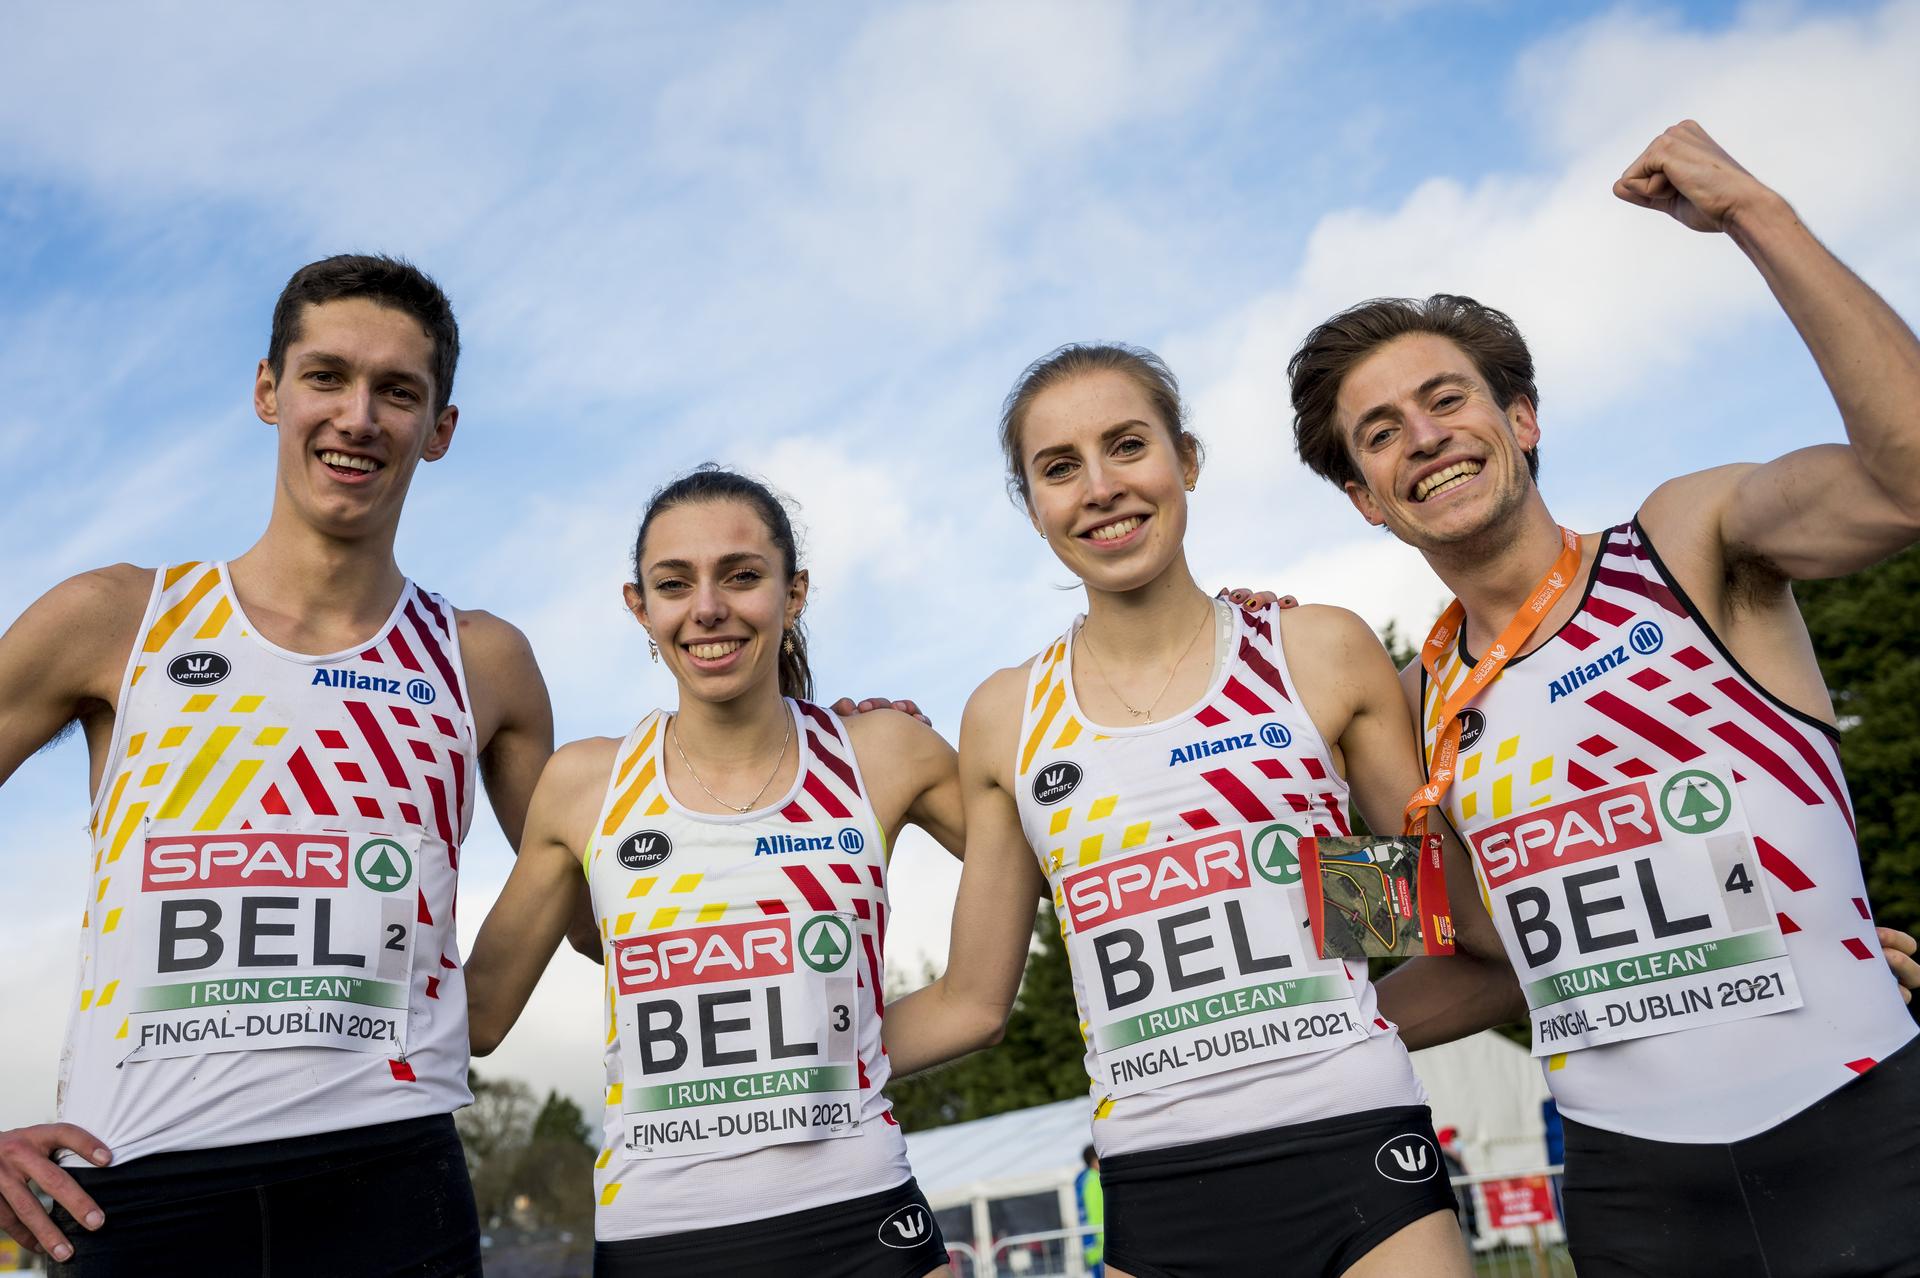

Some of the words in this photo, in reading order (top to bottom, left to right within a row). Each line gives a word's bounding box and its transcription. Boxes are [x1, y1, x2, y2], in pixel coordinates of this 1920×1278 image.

[177, 671, 220, 680] vermarc
[311, 668, 401, 695] Allianz
[1548, 645, 1630, 704] Allianz
[1169, 732, 1257, 767] Allianz
[1459, 728, 1479, 742] marc
[1038, 781, 1072, 799] vermarc
[754, 835, 834, 857] Allianz
[1481, 793, 1652, 878] SPAR
[149, 841, 342, 883] SPAR
[624, 852, 662, 863] vermarc
[1070, 840, 1243, 922] SPAR
[1505, 857, 1712, 969] BEL
[1724, 863, 1754, 894] 4
[157, 897, 366, 973] BEL
[385, 924, 406, 951] 2
[620, 927, 788, 986] SPAR
[1093, 900, 1292, 1011] BEL
[191, 985, 196, 1003] I
[204, 981, 260, 1002] RUN
[1553, 979, 1562, 997] I
[1562, 966, 1610, 995] RUN
[1138, 1018, 1146, 1037] I
[1149, 1006, 1199, 1034] RUN
[1540, 986, 1713, 1043] FINGAL-DUBLIN
[1717, 972, 1786, 1007] 2021
[141, 1013, 344, 1047] FINGAL-DUBLIN
[347, 1015, 396, 1041] 2021
[637, 986, 818, 1075] BEL
[833, 1005, 850, 1032] 3
[1109, 1020, 1290, 1085] FINGAL-DUBLIN
[1293, 1011, 1353, 1040] 2021
[668, 1087, 673, 1105] I
[678, 1080, 726, 1105] RUN
[634, 1106, 806, 1146] FINGAL-DUBLIN
[812, 1103, 852, 1127] 2021
